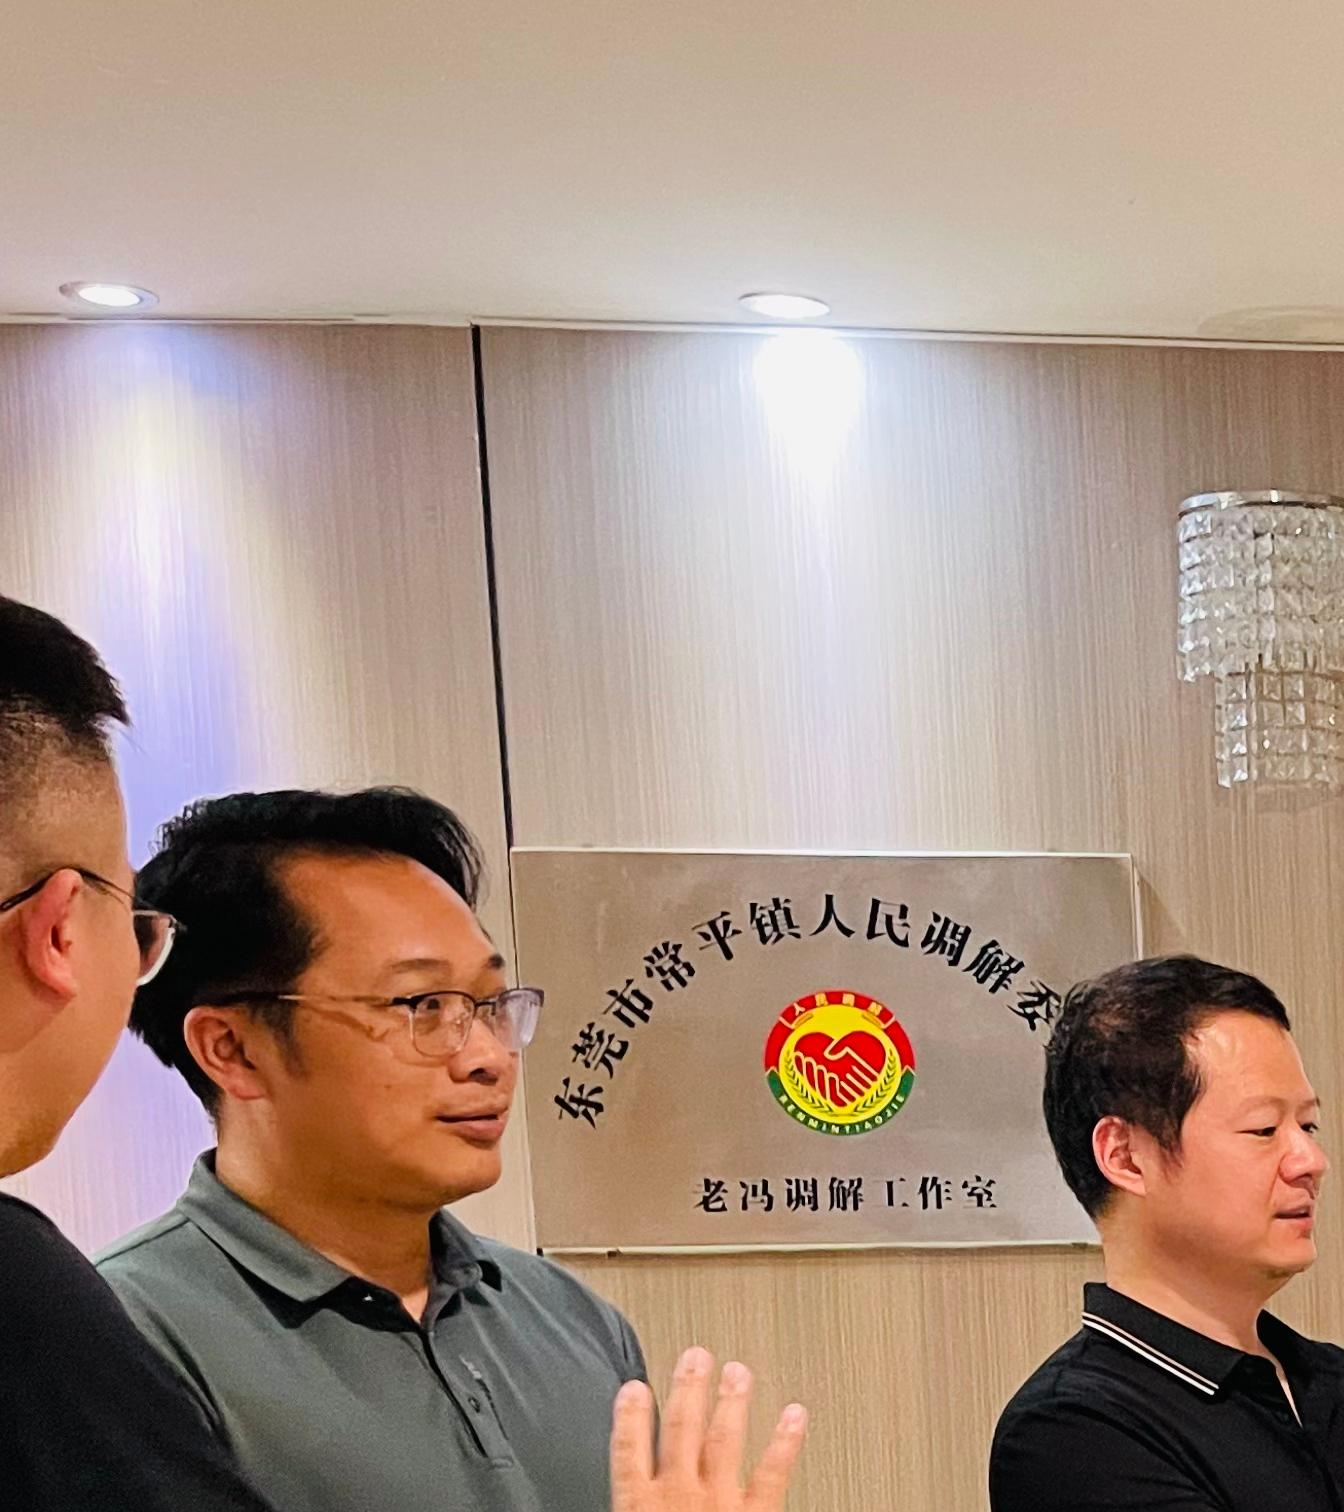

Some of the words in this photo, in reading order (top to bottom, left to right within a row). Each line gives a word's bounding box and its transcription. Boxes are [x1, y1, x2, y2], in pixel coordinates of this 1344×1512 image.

[554, 893, 1061, 1130] 东莞市常平镇人民调解委
[694, 1175, 997, 1213] 老冯调解工作室
